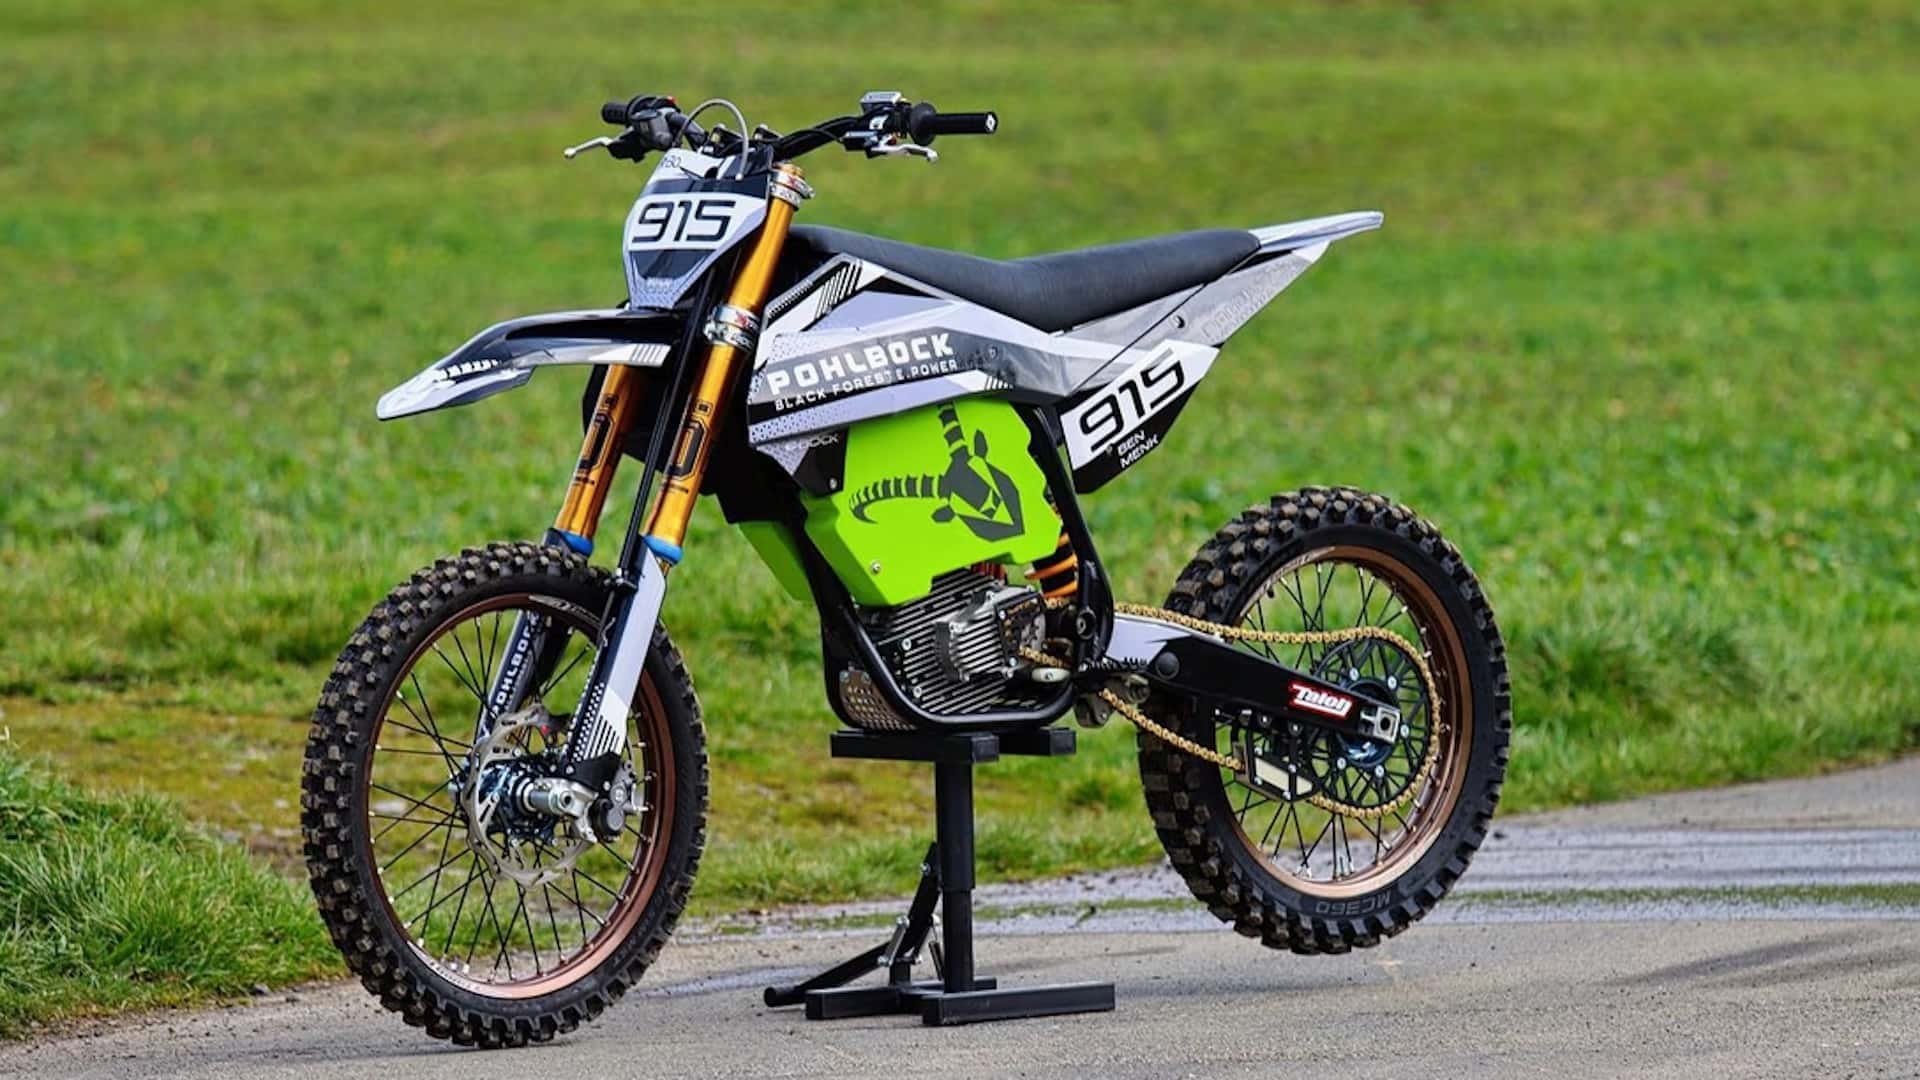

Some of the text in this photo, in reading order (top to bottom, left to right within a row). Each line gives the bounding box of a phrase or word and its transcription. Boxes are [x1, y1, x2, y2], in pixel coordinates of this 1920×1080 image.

[632, 200, 736, 243] 915
[766, 333, 954, 396] POHLBOCK
[775, 387, 828, 412] BLACK
[832, 371, 893, 396] FOREST
[1080, 347, 1185, 452] 915
[1118, 430, 1146, 456] BEN
[1120, 434, 1159, 468] MENK
